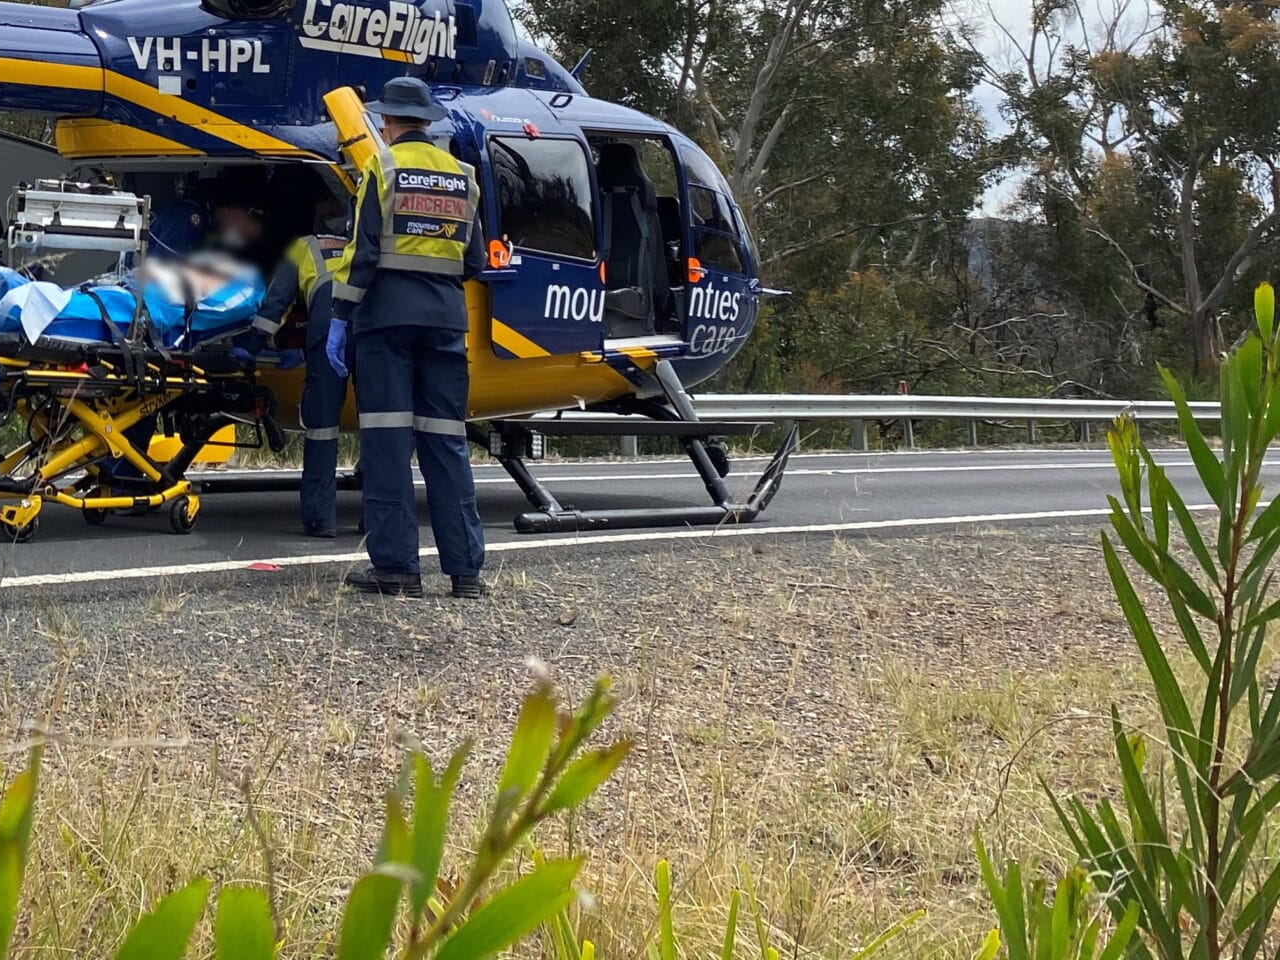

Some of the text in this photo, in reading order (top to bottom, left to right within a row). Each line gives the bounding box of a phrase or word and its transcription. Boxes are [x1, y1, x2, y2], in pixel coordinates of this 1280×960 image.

[127, 37, 270, 74] VH-HPL
[398, 172, 466, 191] CareFlight
[400, 195, 464, 215] AIRCREW
[544, 281, 740, 322] mou nties
[689, 324, 736, 354] care
